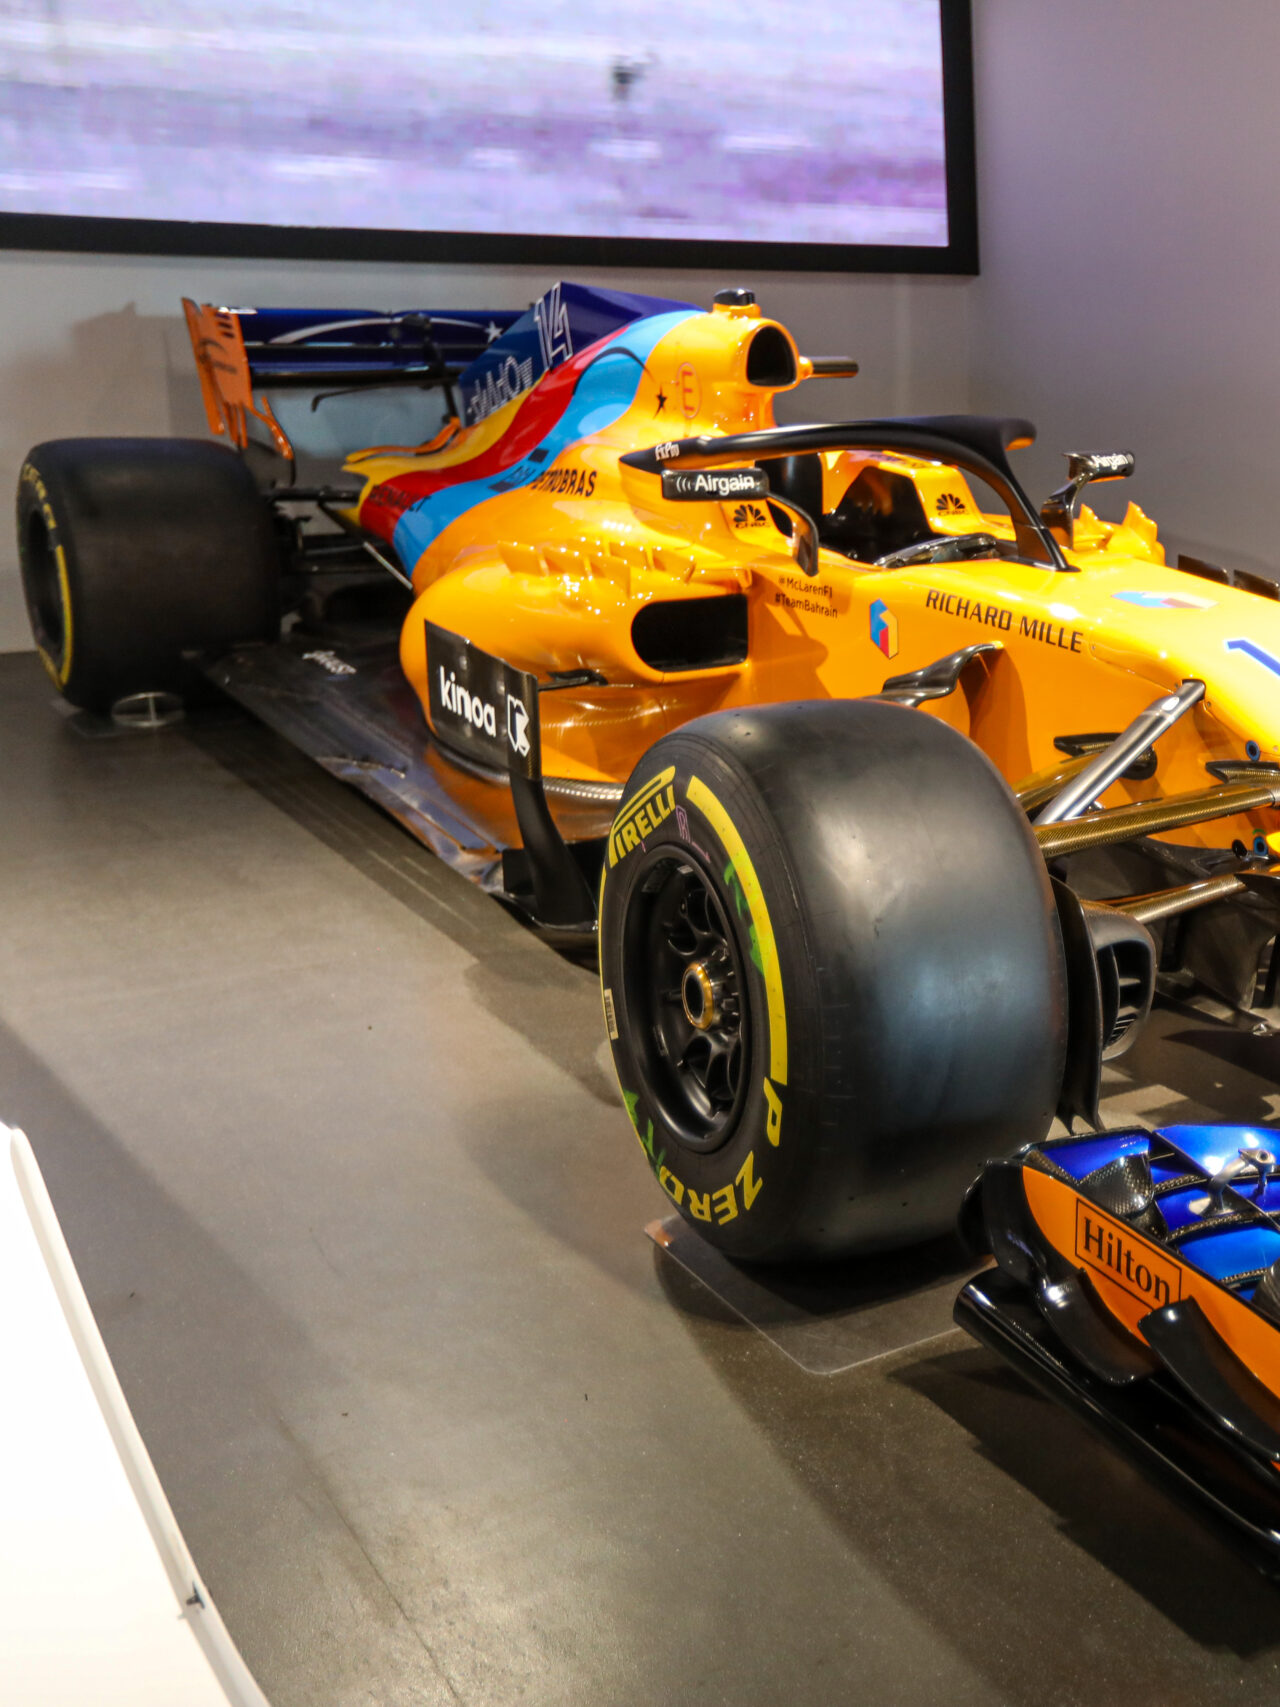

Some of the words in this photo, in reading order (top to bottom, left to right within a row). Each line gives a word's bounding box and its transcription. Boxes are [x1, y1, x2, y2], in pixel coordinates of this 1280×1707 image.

[533, 281, 574, 370] 14
[694, 474, 754, 496] Airgain
[775, 592, 838, 618] #TeamBahrain
[926, 589, 1012, 631] RICHARD
[1019, 615, 1084, 653] MILLE
[440, 665, 497, 737] kimoa
[609, 765, 676, 868] PIRELLI
[764, 1077, 783, 1146] P
[659, 1151, 763, 1225] ZERO
[1084, 1216, 1170, 1306] Hilton
